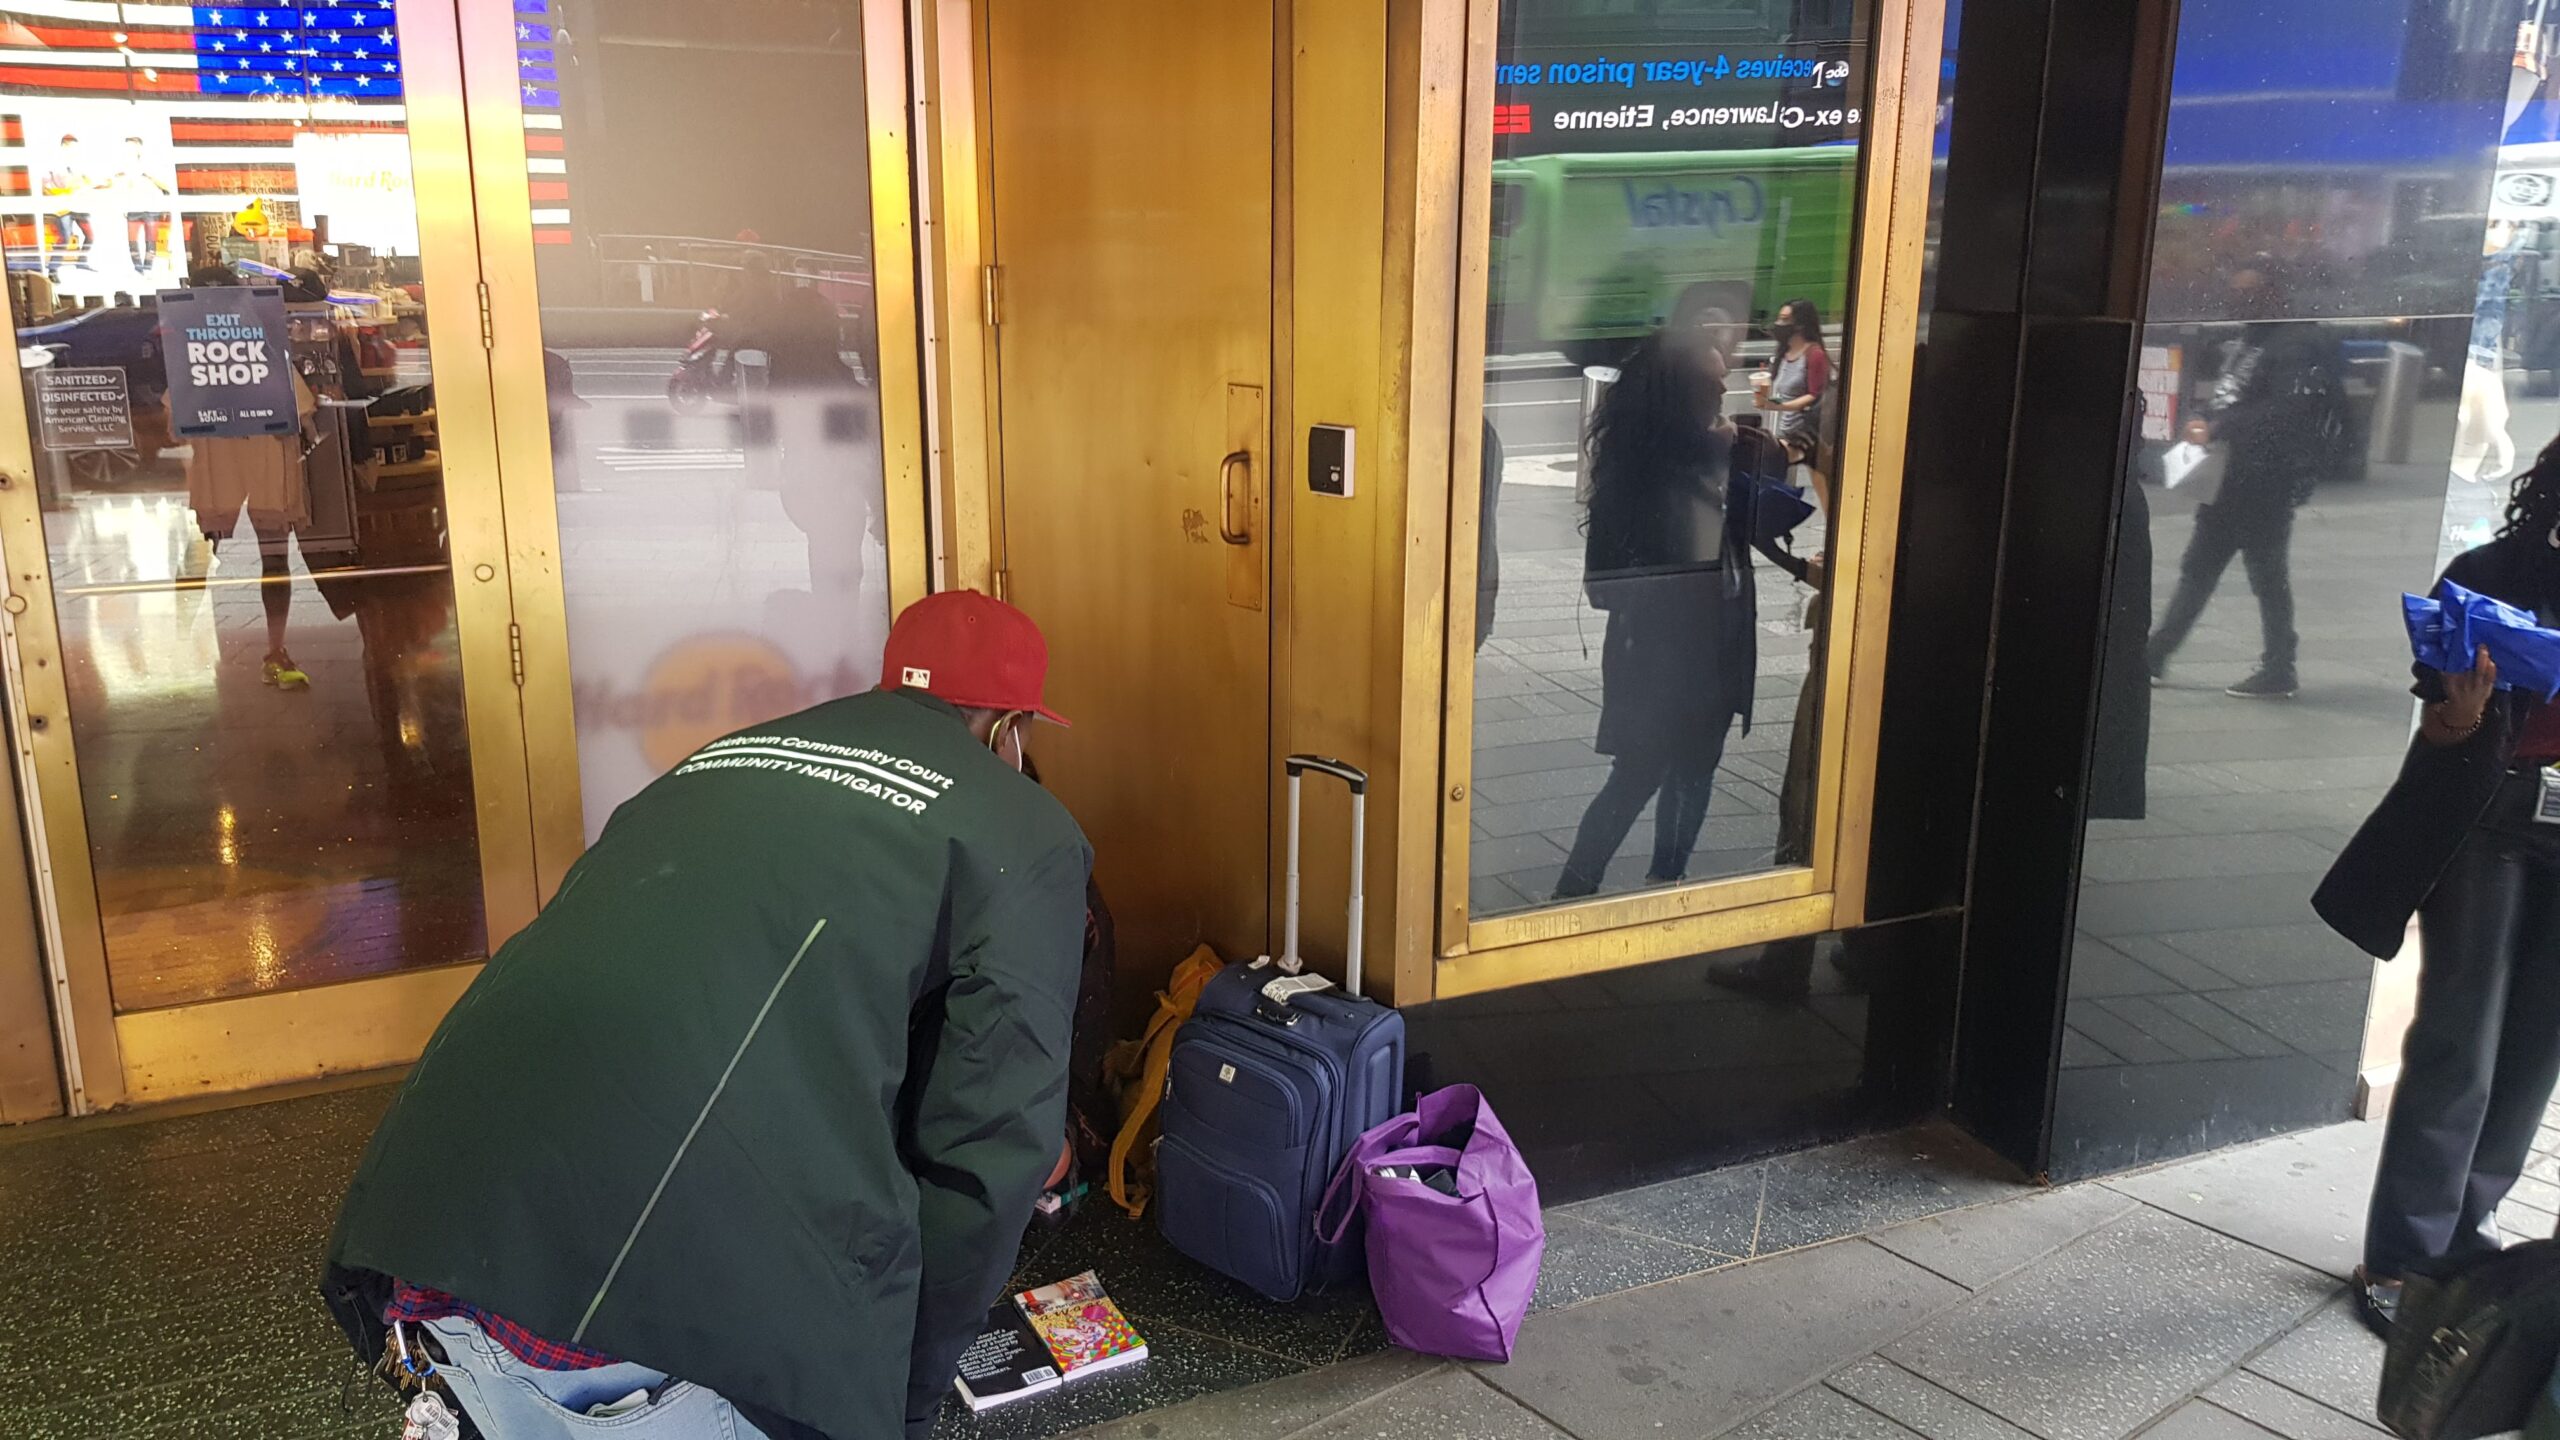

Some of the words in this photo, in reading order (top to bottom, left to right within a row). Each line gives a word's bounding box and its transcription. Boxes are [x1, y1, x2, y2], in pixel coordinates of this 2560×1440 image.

[206, 313, 241, 326] EXIT
[186, 327, 263, 340] THROUGH
[187, 341, 268, 363] ROCK
[46, 375, 107, 386] SANITIZED
[191, 363, 269, 386] SHOP
[42, 392, 116, 402] DISINFECTED
[45, 407, 58, 415] for
[60, 407, 80, 415] your
[83, 406, 110, 414] safety
[112, 405, 123, 413] by
[45, 416, 87, 424] American
[88, 415, 127, 424] Cleaning
[99, 424, 114, 432] LLC
[781, 737, 895, 765] Community
[895, 759, 954, 790] Court
[675, 757, 803, 776] COMMUNITY
[799, 764, 927, 815] NAVIGATOR
